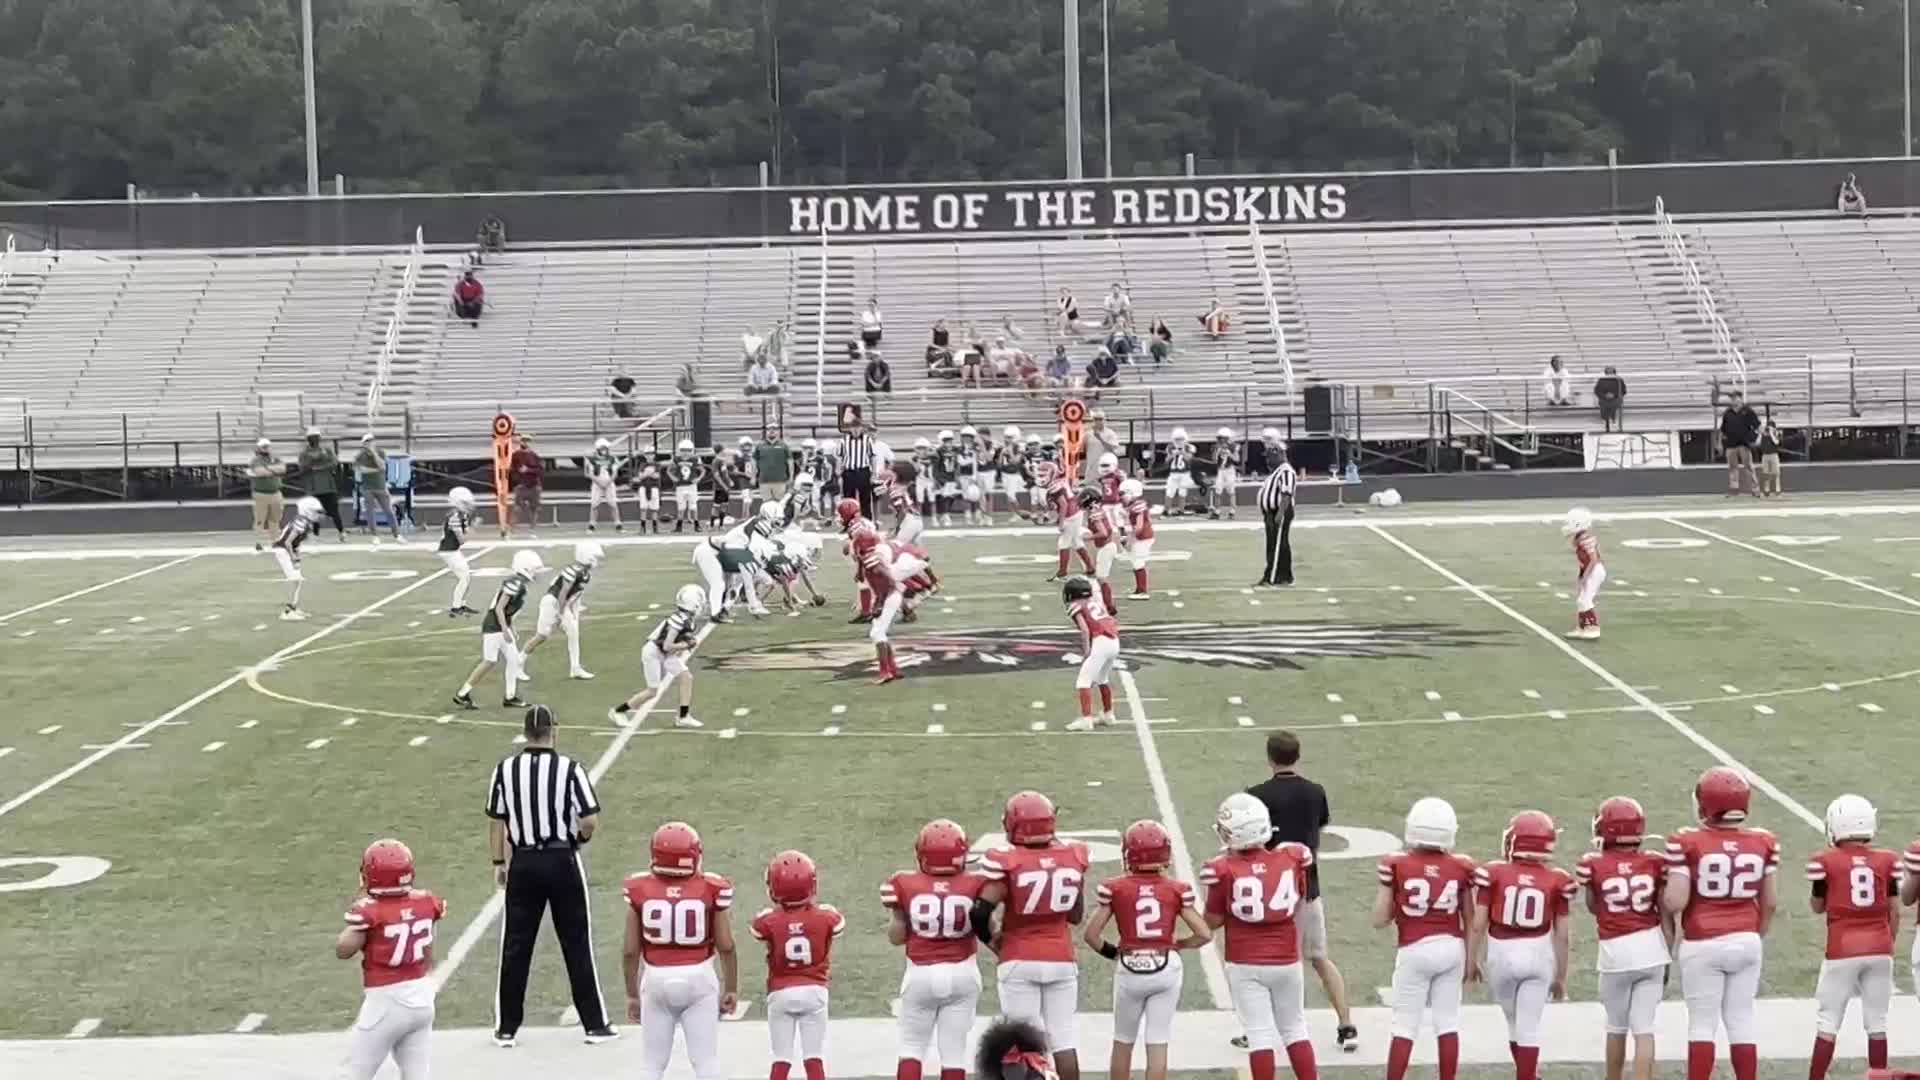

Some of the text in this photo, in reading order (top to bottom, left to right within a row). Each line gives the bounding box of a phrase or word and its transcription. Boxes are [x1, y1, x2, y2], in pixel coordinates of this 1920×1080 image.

[789, 184, 1348, 233] HOME OF THE REDSKINS
[681, 466, 691, 480] 9
[1251, 863, 1267, 874] SC
[1616, 862, 1633, 874] SC
[1697, 853, 1765, 898] 82
[1850, 866, 1875, 907] 8
[666, 887, 682, 898] SC
[1017, 867, 1082, 914] 76
[1231, 869, 1300, 922] 84
[1401, 878, 1459, 917] 34
[1503, 885, 1545, 928] 10
[1602, 874, 1655, 912] 22
[642, 899, 706, 945] 90
[788, 922, 804, 934] SC
[910, 893, 973, 938] 80
[1135, 897, 1162, 938] 2
[384, 918, 433, 966] 72
[785, 936, 812, 968] 9
